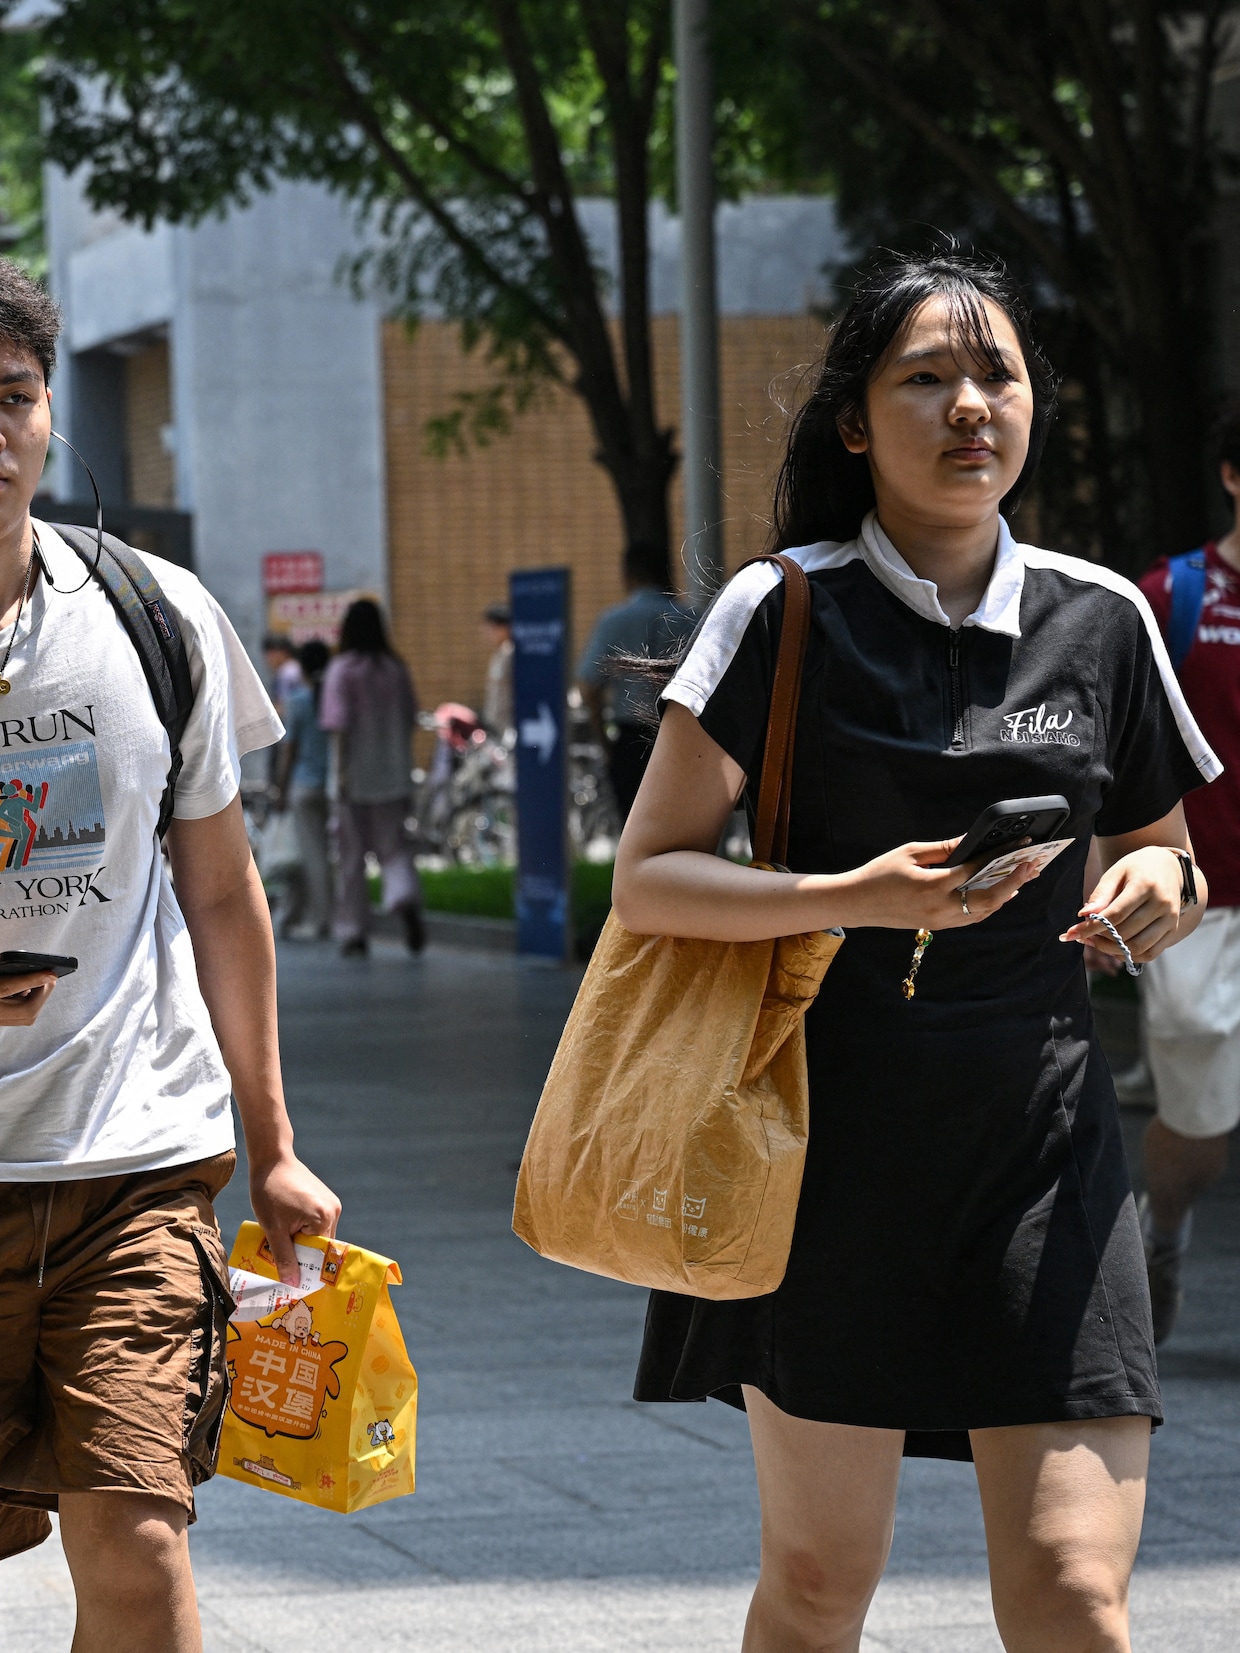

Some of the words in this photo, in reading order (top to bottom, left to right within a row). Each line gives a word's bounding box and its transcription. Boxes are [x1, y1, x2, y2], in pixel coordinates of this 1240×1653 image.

[1003, 703, 1073, 740] Fila
[1031, 731, 1081, 746] SIAMO
[15, 866, 112, 907] YORK
[255, 1334, 286, 1349] MADE
[289, 1344, 299, 1353] IN
[301, 1348, 321, 1361] CHINA
[249, 1349, 319, 1391] 中国
[240, 1375, 313, 1420] 汉堡
